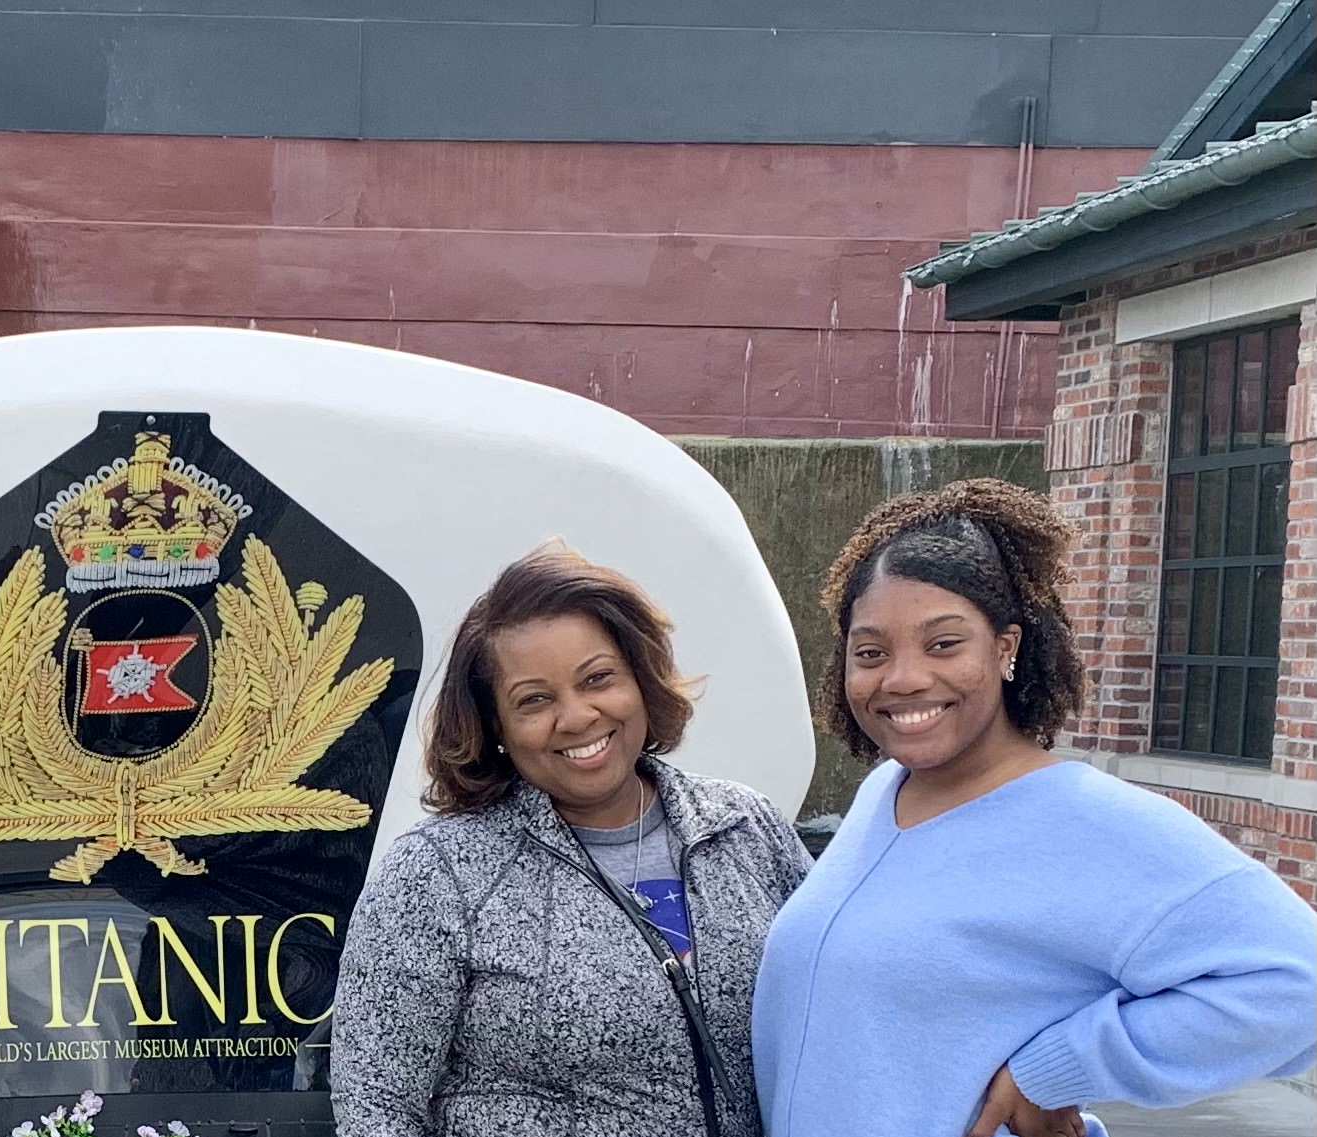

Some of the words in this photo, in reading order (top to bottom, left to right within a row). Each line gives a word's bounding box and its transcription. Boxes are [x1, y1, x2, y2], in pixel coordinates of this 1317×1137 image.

[37, 1040, 110, 1061] LARGEST
[114, 1038, 189, 1059] MUSEUM
[192, 1037, 299, 1058] ATTRACTION
